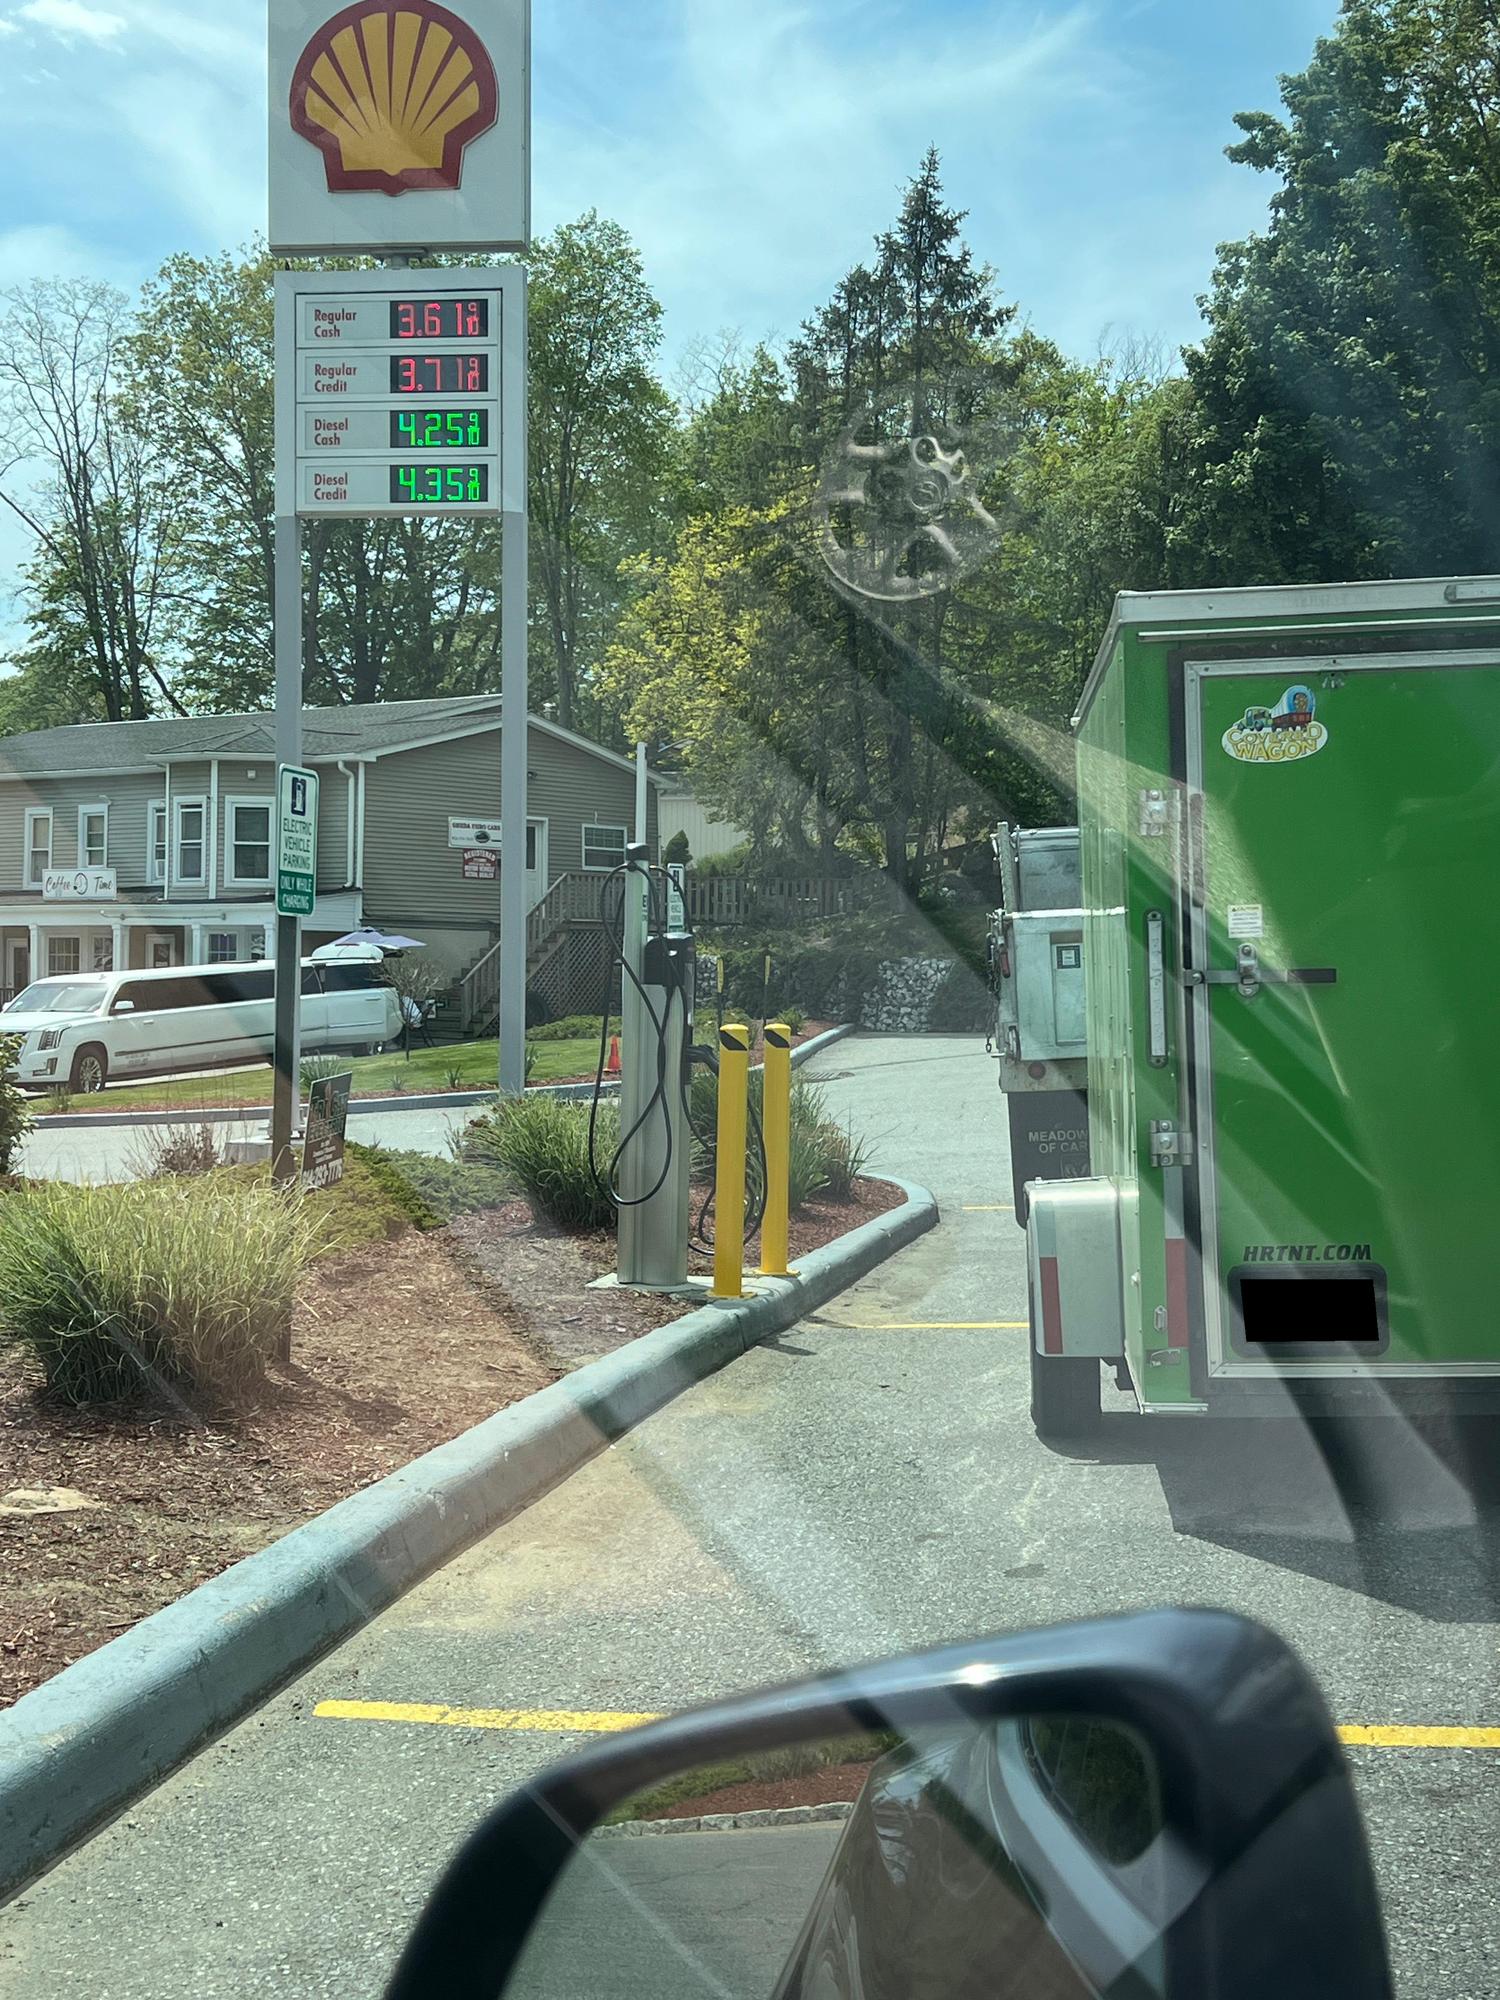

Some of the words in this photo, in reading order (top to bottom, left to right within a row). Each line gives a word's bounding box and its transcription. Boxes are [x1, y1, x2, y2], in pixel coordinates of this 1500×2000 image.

[314, 309, 357, 322] Regular
[314, 326, 340, 338] Cash
[314, 364, 357, 377] Regular
[314, 380, 347, 392] Credit
[314, 418, 348, 431] Diesel
[314, 434, 340, 446] Cash
[314, 473, 348, 486] Diesel
[314, 489, 347, 501] Credit
[1227, 723, 1322, 745] COVERED
[1231, 739, 1318, 761] WAGON
[283, 818, 312, 836] ELECTRIC
[284, 836, 311, 853] VEHICLE
[283, 852, 311, 870] PARKING
[45, 876, 71, 894] Coffee
[93, 876, 112, 894] Time
[280, 875, 295, 890] ONLY
[296, 877, 313, 893] WHILE
[282, 893, 310, 910] CHARGING
[1039, 1142, 1057, 1153] OF
[1243, 1244, 1372, 1262] HRTNT.COM
